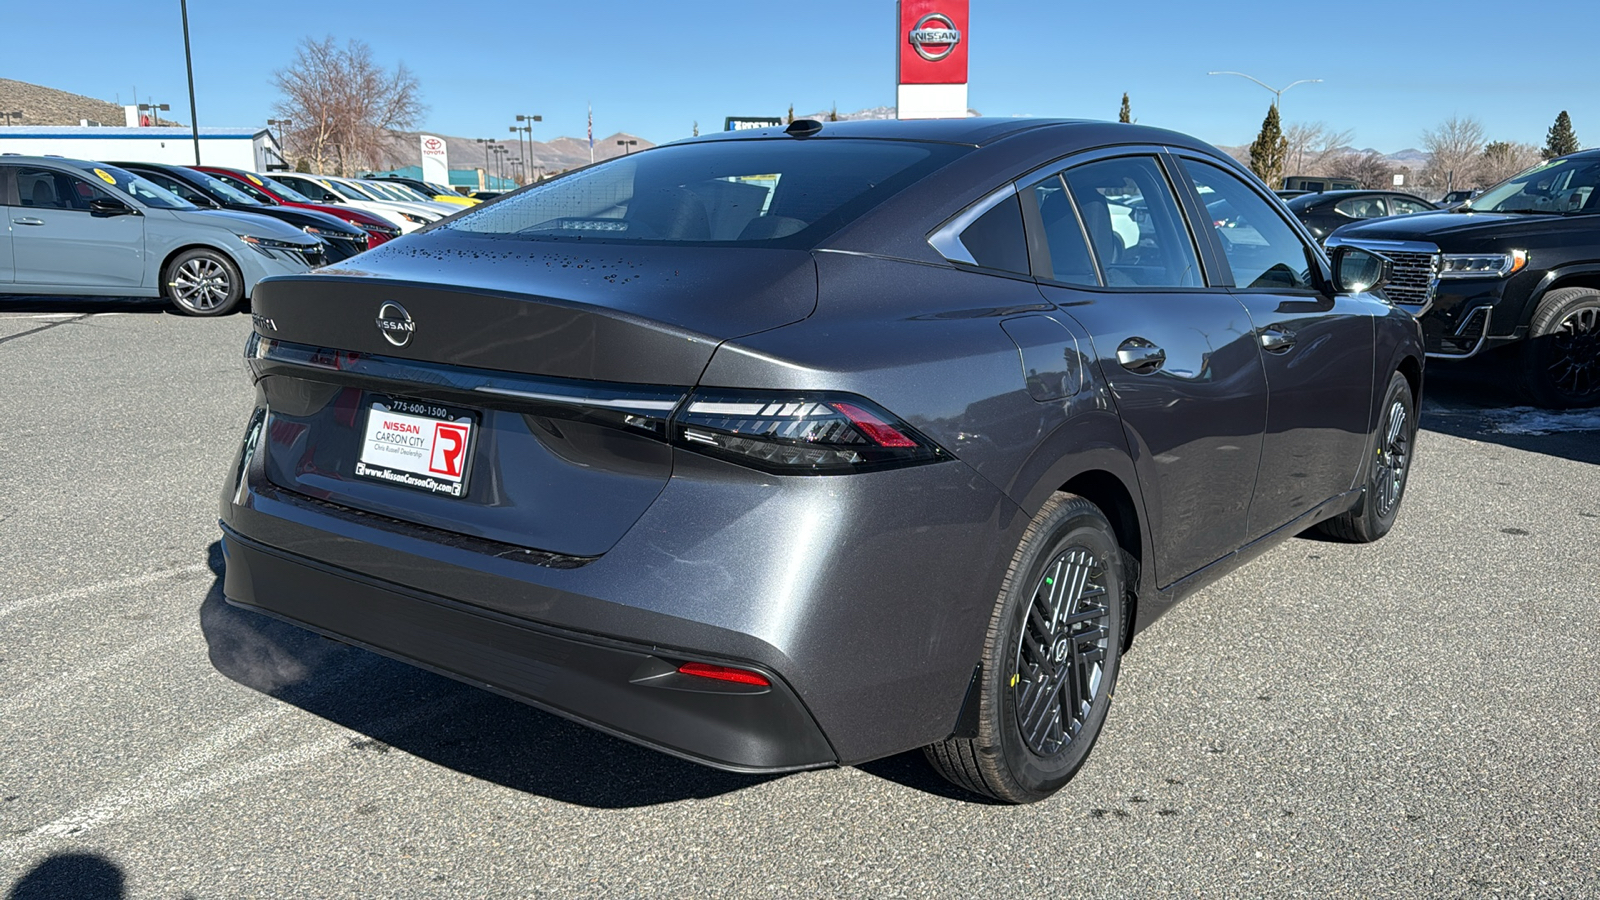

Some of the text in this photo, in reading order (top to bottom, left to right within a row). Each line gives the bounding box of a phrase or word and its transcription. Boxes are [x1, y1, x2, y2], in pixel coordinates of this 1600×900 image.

[915, 32, 957, 41] NISSAN
[375, 318, 413, 332] NISSAN
[393, 400, 447, 418] 775-600-1500
[383, 420, 420, 434] NISSAN
[375, 430, 425, 447] CARSON CITY
[365, 467, 452, 492] www.NissanCarsonCity.com
